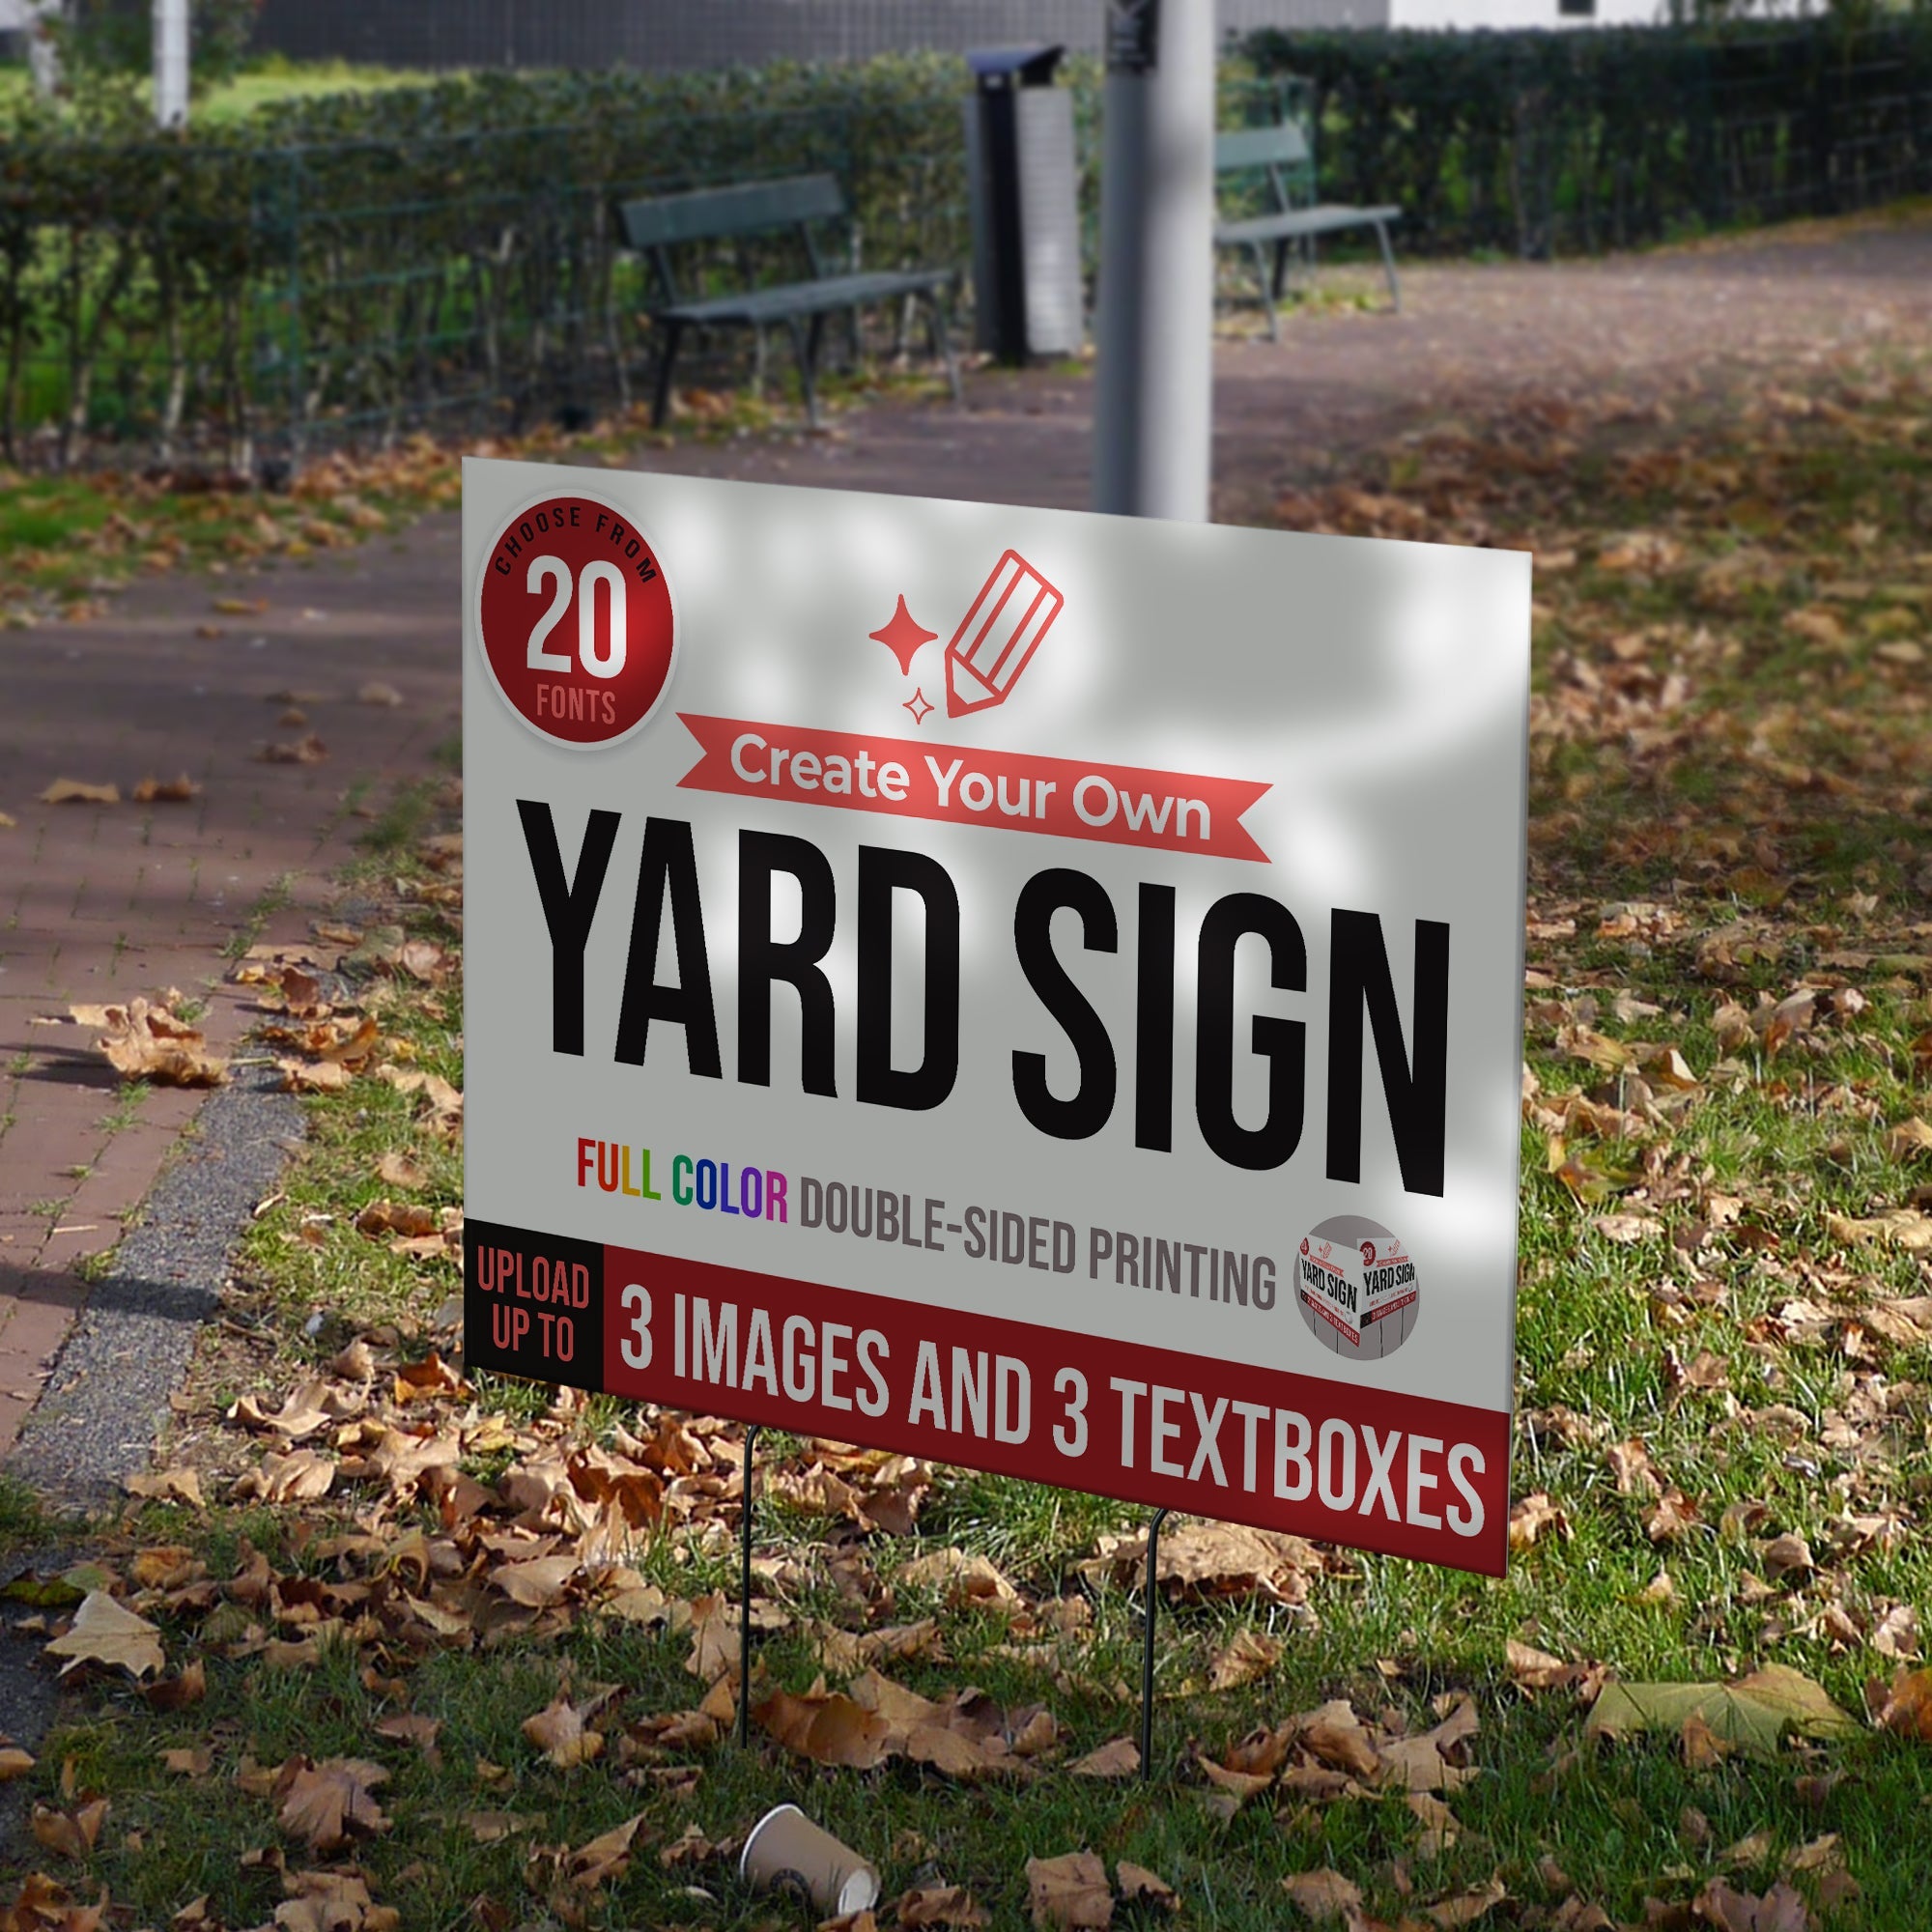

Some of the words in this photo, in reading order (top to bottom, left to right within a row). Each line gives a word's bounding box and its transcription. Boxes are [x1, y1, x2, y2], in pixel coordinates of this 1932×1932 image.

[495, 506, 581, 576] CHOOSE
[595, 513, 657, 583] FROM
[526, 554, 627, 679] 20
[536, 683, 616, 724] FONTS
[730, 733, 910, 802] Create
[924, 755, 1056, 819] Your
[1073, 775, 1211, 840] Own
[516, 799, 960, 1112] YARD
[1011, 867, 1450, 1198] SIGN
[577, 1137, 662, 1202] FULL
[672, 1154, 788, 1224] COLOR
[800, 1177, 1076, 1274] DOUBLE-SIDED
[1089, 1227, 1276, 1311] PRINTING
[478, 1245, 590, 1309] UPLOAD
[1300, 1258, 1325, 1292] YARD
[1327, 1272, 1357, 1313] SIGN
[1363, 1266, 1394, 1296] YARD
[1395, 1263, 1414, 1286] SIGN
[493, 1303, 530, 1351] UP
[538, 1313, 575, 1362] TO
[620, 1284, 653, 1370] 3
[674, 1293, 890, 1417] IMAGES
[908, 1340, 1032, 1445] AND
[1053, 1368, 1089, 1458] 3
[1110, 1376, 1486, 1538] TEXTBOXES
